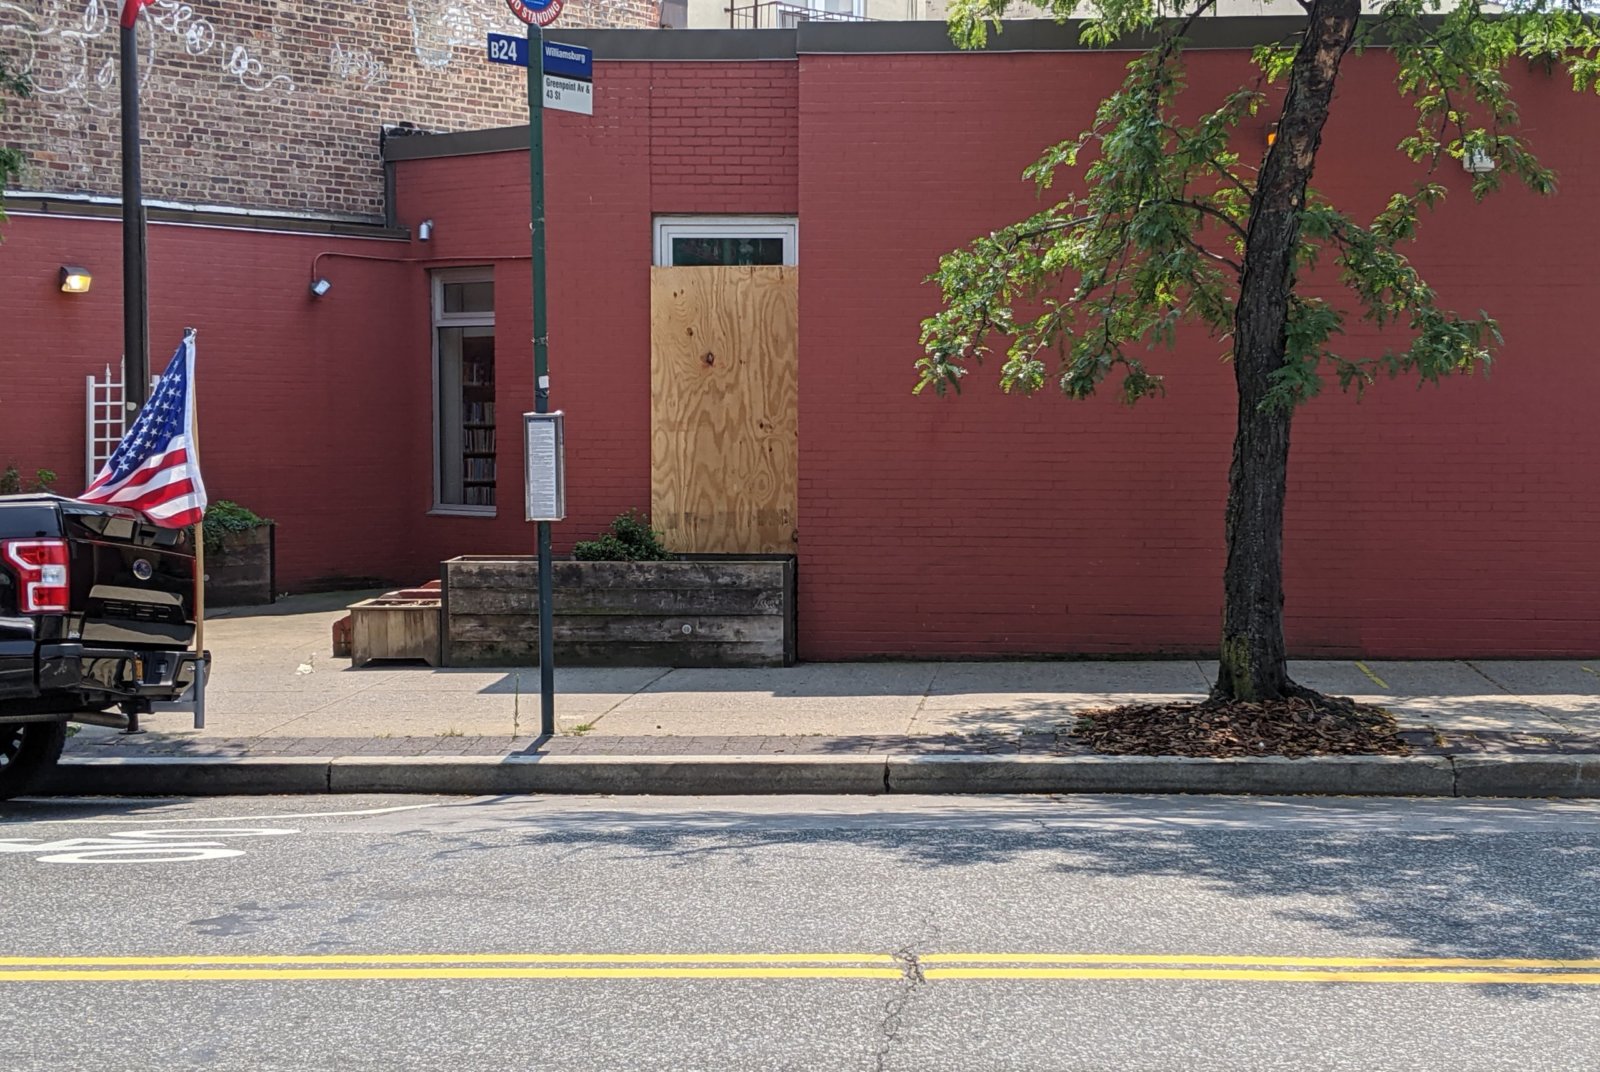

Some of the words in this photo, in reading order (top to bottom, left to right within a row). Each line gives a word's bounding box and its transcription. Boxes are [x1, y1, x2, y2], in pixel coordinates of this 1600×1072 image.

[521, 1, 560, 24] STANDING
[490, 39, 517, 61] B24
[545, 46, 585, 64] Williamsburg
[545, 77, 576, 91] Greenpoint
[577, 83, 584, 93] Av
[586, 85, 590, 94] &
[546, 89, 553, 99] 43
[555, 91, 561, 100] St
